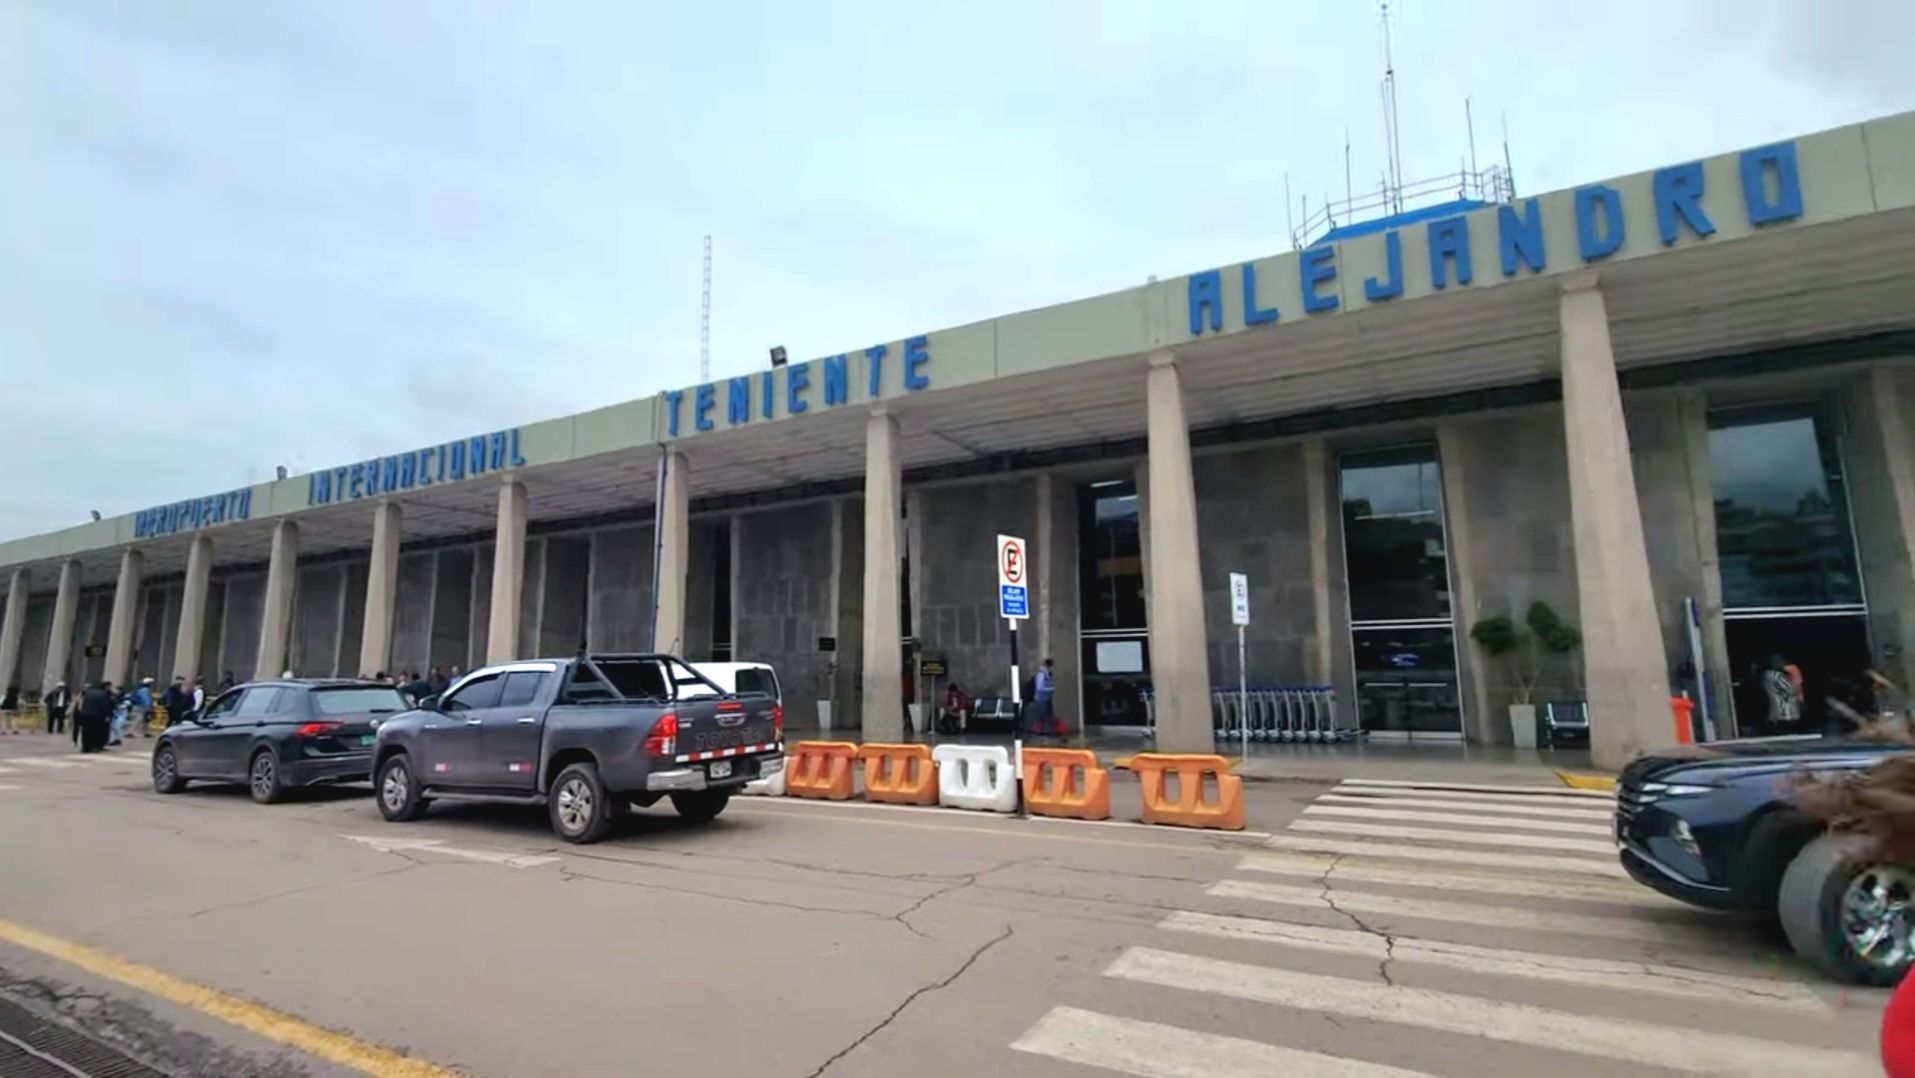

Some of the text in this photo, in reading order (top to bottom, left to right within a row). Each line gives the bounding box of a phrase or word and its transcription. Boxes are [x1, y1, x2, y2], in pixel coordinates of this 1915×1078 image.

[134, 140, 1804, 538] AEROPUERTO INTERNACIONAL TENIENTE ALEJANDRO
[1008, 548, 1018, 575] E
